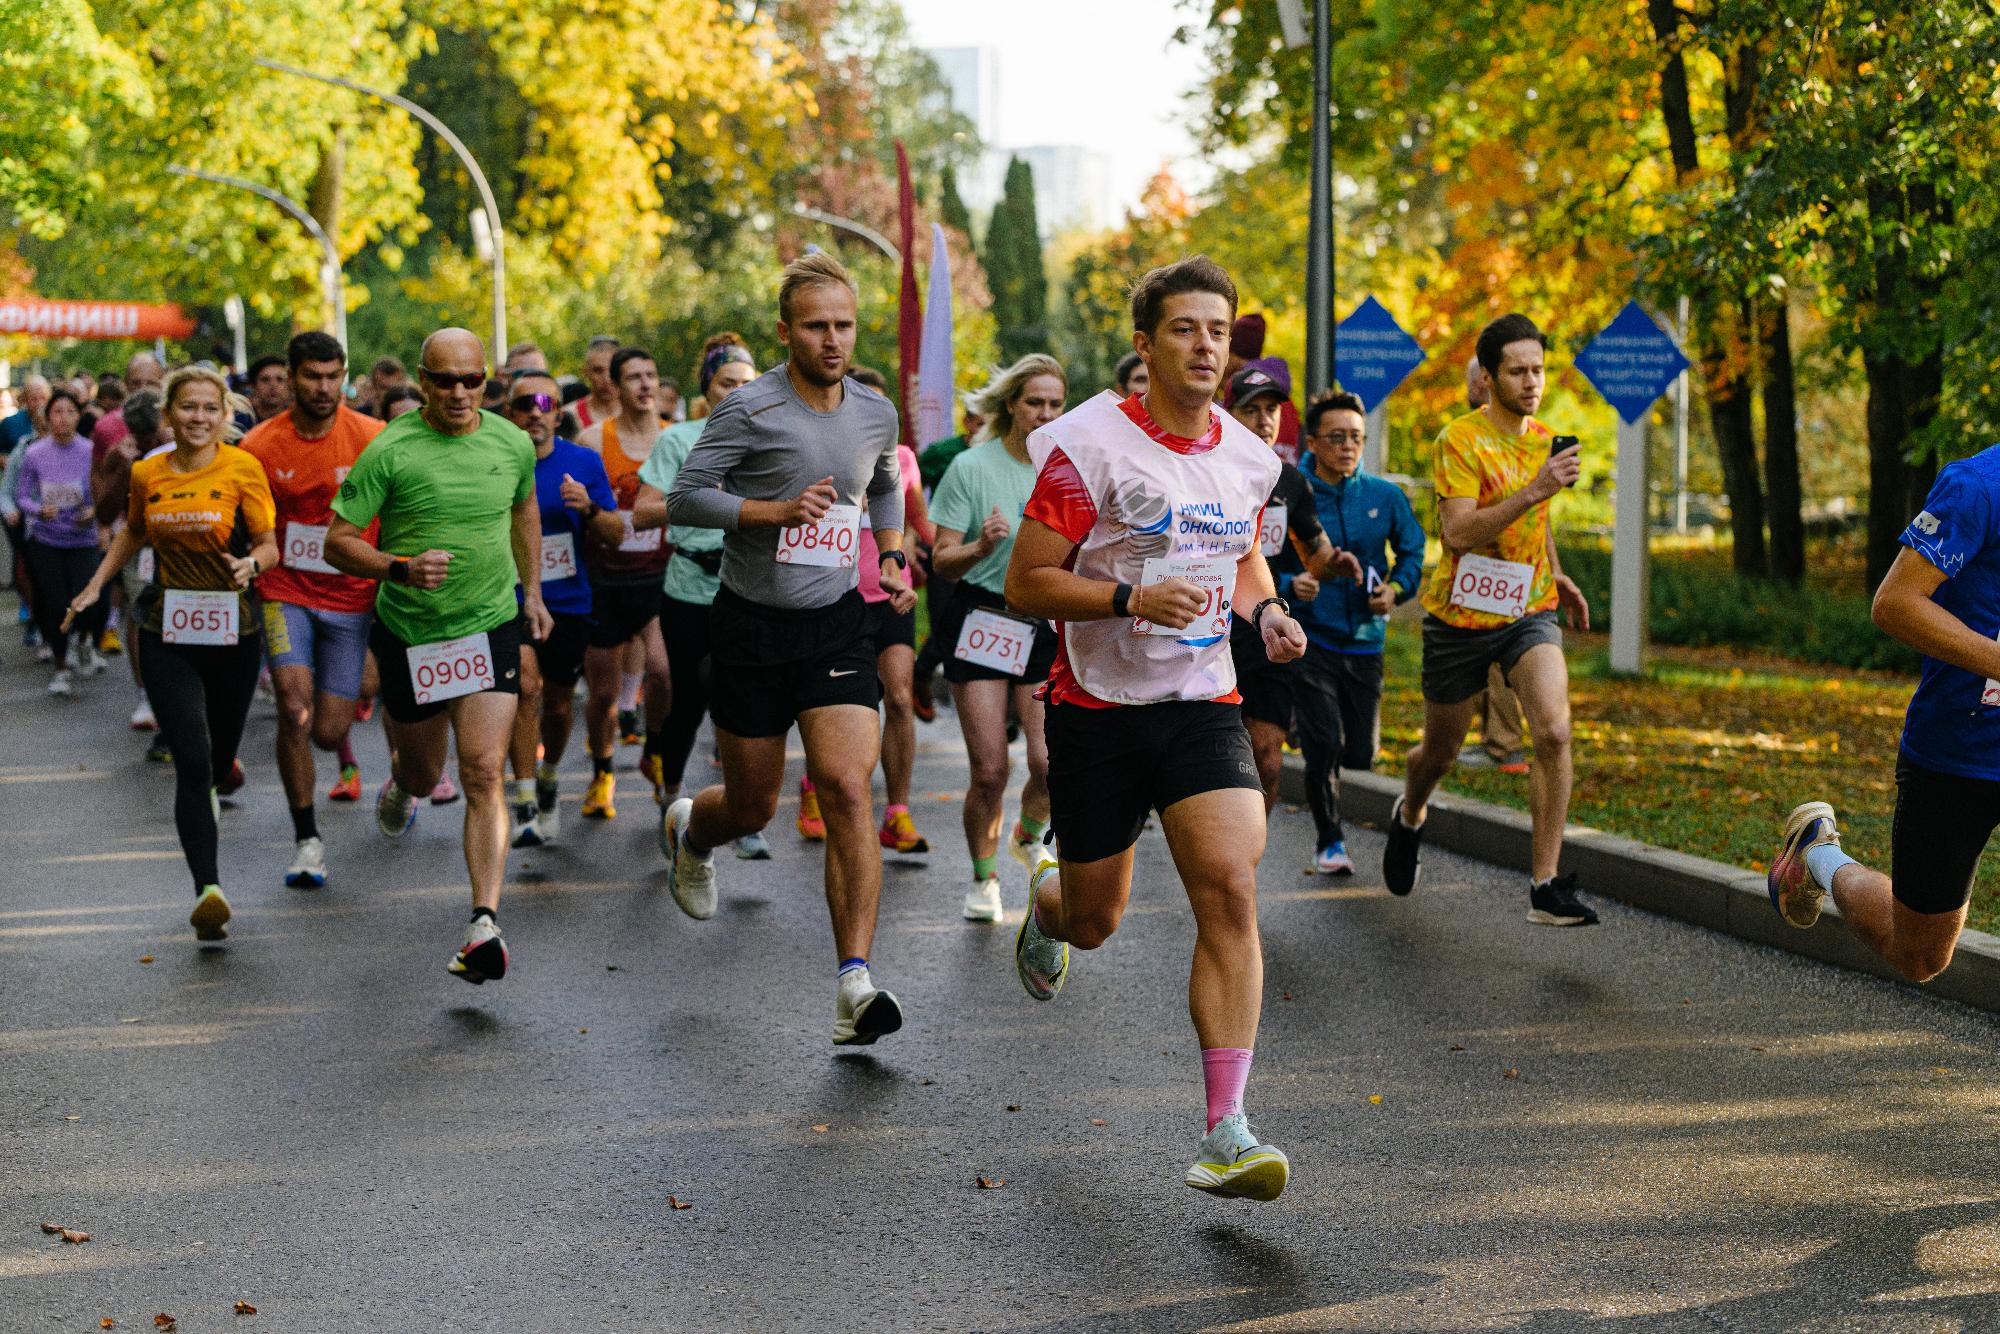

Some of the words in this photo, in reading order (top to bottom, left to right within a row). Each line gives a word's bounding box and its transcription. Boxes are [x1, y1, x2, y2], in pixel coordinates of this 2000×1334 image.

[1180, 502, 1224, 518] НМИЦ
[785, 525, 853, 552] 0840
[1260, 525, 1283, 545] 60
[290, 539, 320, 560] 08
[545, 549, 571, 569] 54
[1460, 572, 1524, 604] 0884
[172, 608, 230, 632] 0651
[969, 629, 1022, 661] 0731
[417, 654, 487, 688] 0908
